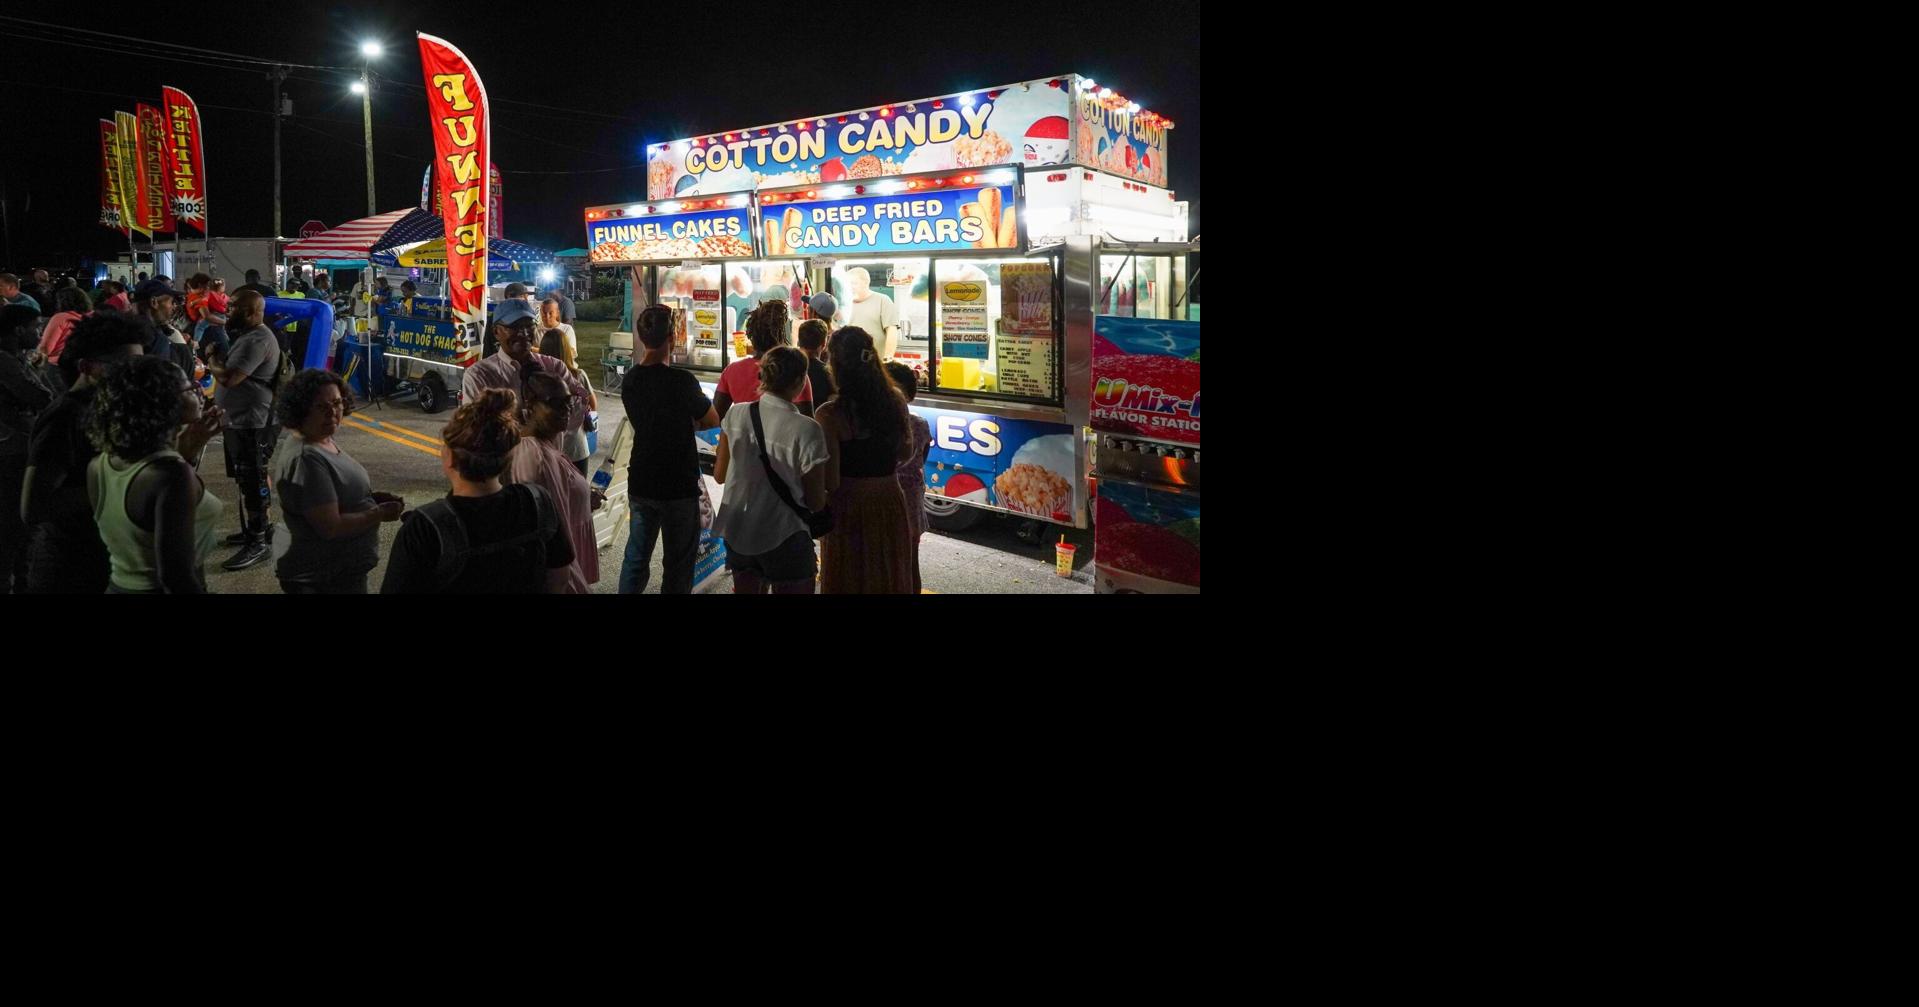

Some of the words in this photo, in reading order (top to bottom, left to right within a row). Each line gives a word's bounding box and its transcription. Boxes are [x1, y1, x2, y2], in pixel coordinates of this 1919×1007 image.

[1080, 91, 1130, 137] COTTON
[1132, 116, 1164, 152] CANDY
[685, 128, 826, 175] COTTON
[838, 102, 994, 155] CANDY
[811, 203, 867, 224] DEEP
[874, 199, 943, 221] FRIED
[594, 223, 668, 244] FUNNEL
[672, 216, 742, 240] CAKES
[785, 222, 881, 249] CANDY
[890, 215, 984, 246] BARS
[945, 287, 981, 295] Lemonade
[400, 331, 414, 343] HOT
[416, 332, 431, 346] DOG
[434, 335, 457, 350] SHAC
[424, 325, 437, 334] THE
[964, 334, 989, 343] CONES
[1095, 408, 1148, 425] FLAVOR
[1151, 416, 1200, 432] STATIO
[929, 415, 1002, 456] ES
